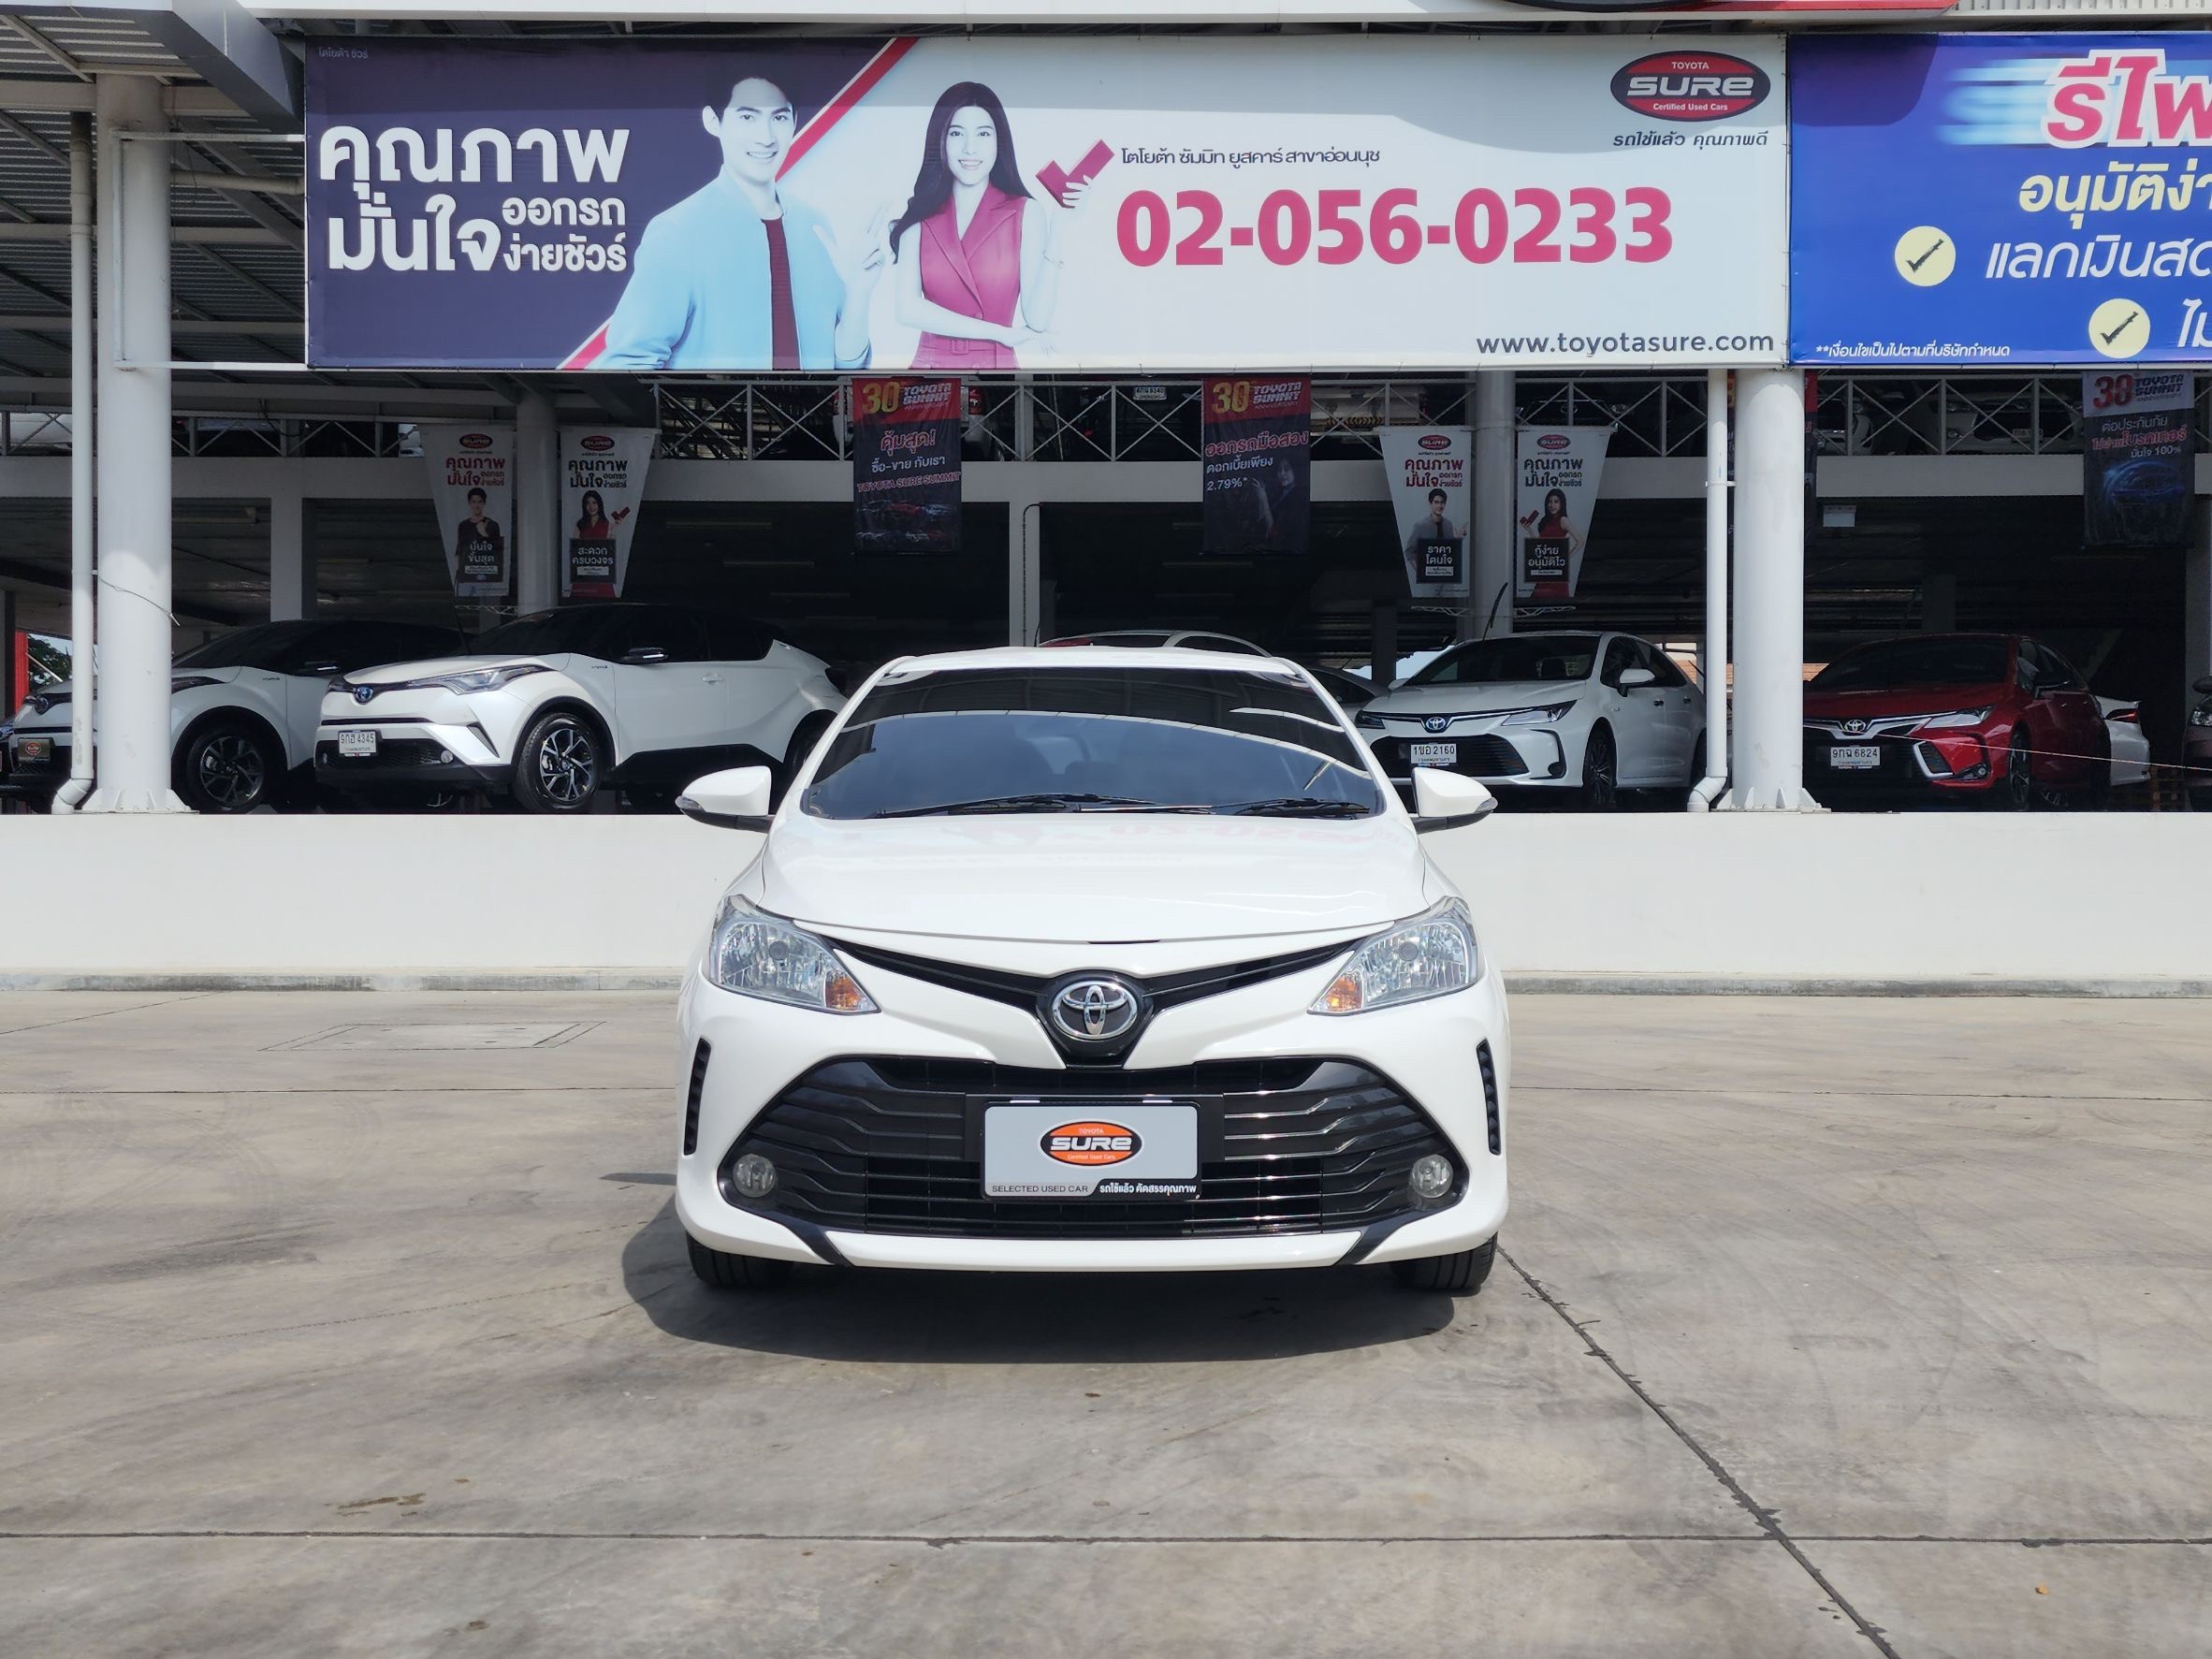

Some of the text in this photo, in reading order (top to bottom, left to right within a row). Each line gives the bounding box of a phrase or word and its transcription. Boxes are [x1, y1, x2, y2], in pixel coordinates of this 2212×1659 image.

[1671, 61, 1710, 70] TOYOTA
[1626, 76, 1755, 96] SURE
[1652, 102, 1729, 111] Certified Used Cars
[1612, 130, 1769, 151] รถใช้แล้ว คุณภาพดี
[320, 125, 631, 199] คุณภาพ
[1121, 146, 1380, 168] โตโยต้า ซัมมิท ยูสคาร์ สาขาอ่อนนุช
[502, 196, 626, 226] ออกรถ
[328, 192, 502, 271] มั่นใจ
[1116, 187, 1673, 267] 02-056-0233
[502, 231, 627, 271] ง่ายชัวร์
[1477, 330, 1774, 357] www.toyotasure.com
[2135, 374, 2184, 386] TOYOTA
[904, 383, 952, 396] TOYOTA
[1254, 382, 1302, 395] TOYOTA
[2135, 384, 2183, 396] SUMMIT
[863, 382, 899, 414] 30
[903, 393, 950, 404] SUMMIT
[1213, 381, 1250, 413] 30
[1253, 392, 1301, 403] SUMMIT
[1205, 430, 1309, 457] ออกรถมือสอง
[445, 458, 505, 473] คุณภาพ
[568, 459, 627, 474] คุณภาพ
[915, 456, 945, 468] กับเรา
[1404, 458, 1463, 473] คุณภาพ
[1523, 458, 1582, 473] คุณภาพ
[447, 471, 479, 486] มั่นใจ
[570, 473, 603, 488] มั่นใจ
[857, 480, 896, 492] TOYOTA
[923, 472, 962, 485] SUMMIT
[1406, 471, 1438, 487] มั่นใจ
[1525, 471, 1558, 487] มั่นใจ
[1426, 553, 1453, 564] โดนใจ
[1535, 544, 1559, 558] กู้ง่าย
[572, 556, 614, 564] ครบวงจร
[1433, 746, 1454, 754] 2160
[1855, 749, 1877, 757] 6824
[1050, 1136, 1132, 1151] SURE
[992, 1184, 1088, 1193] SELECTED USED CAR
[1099, 1181, 1134, 1194] รถใช้แล้ว
